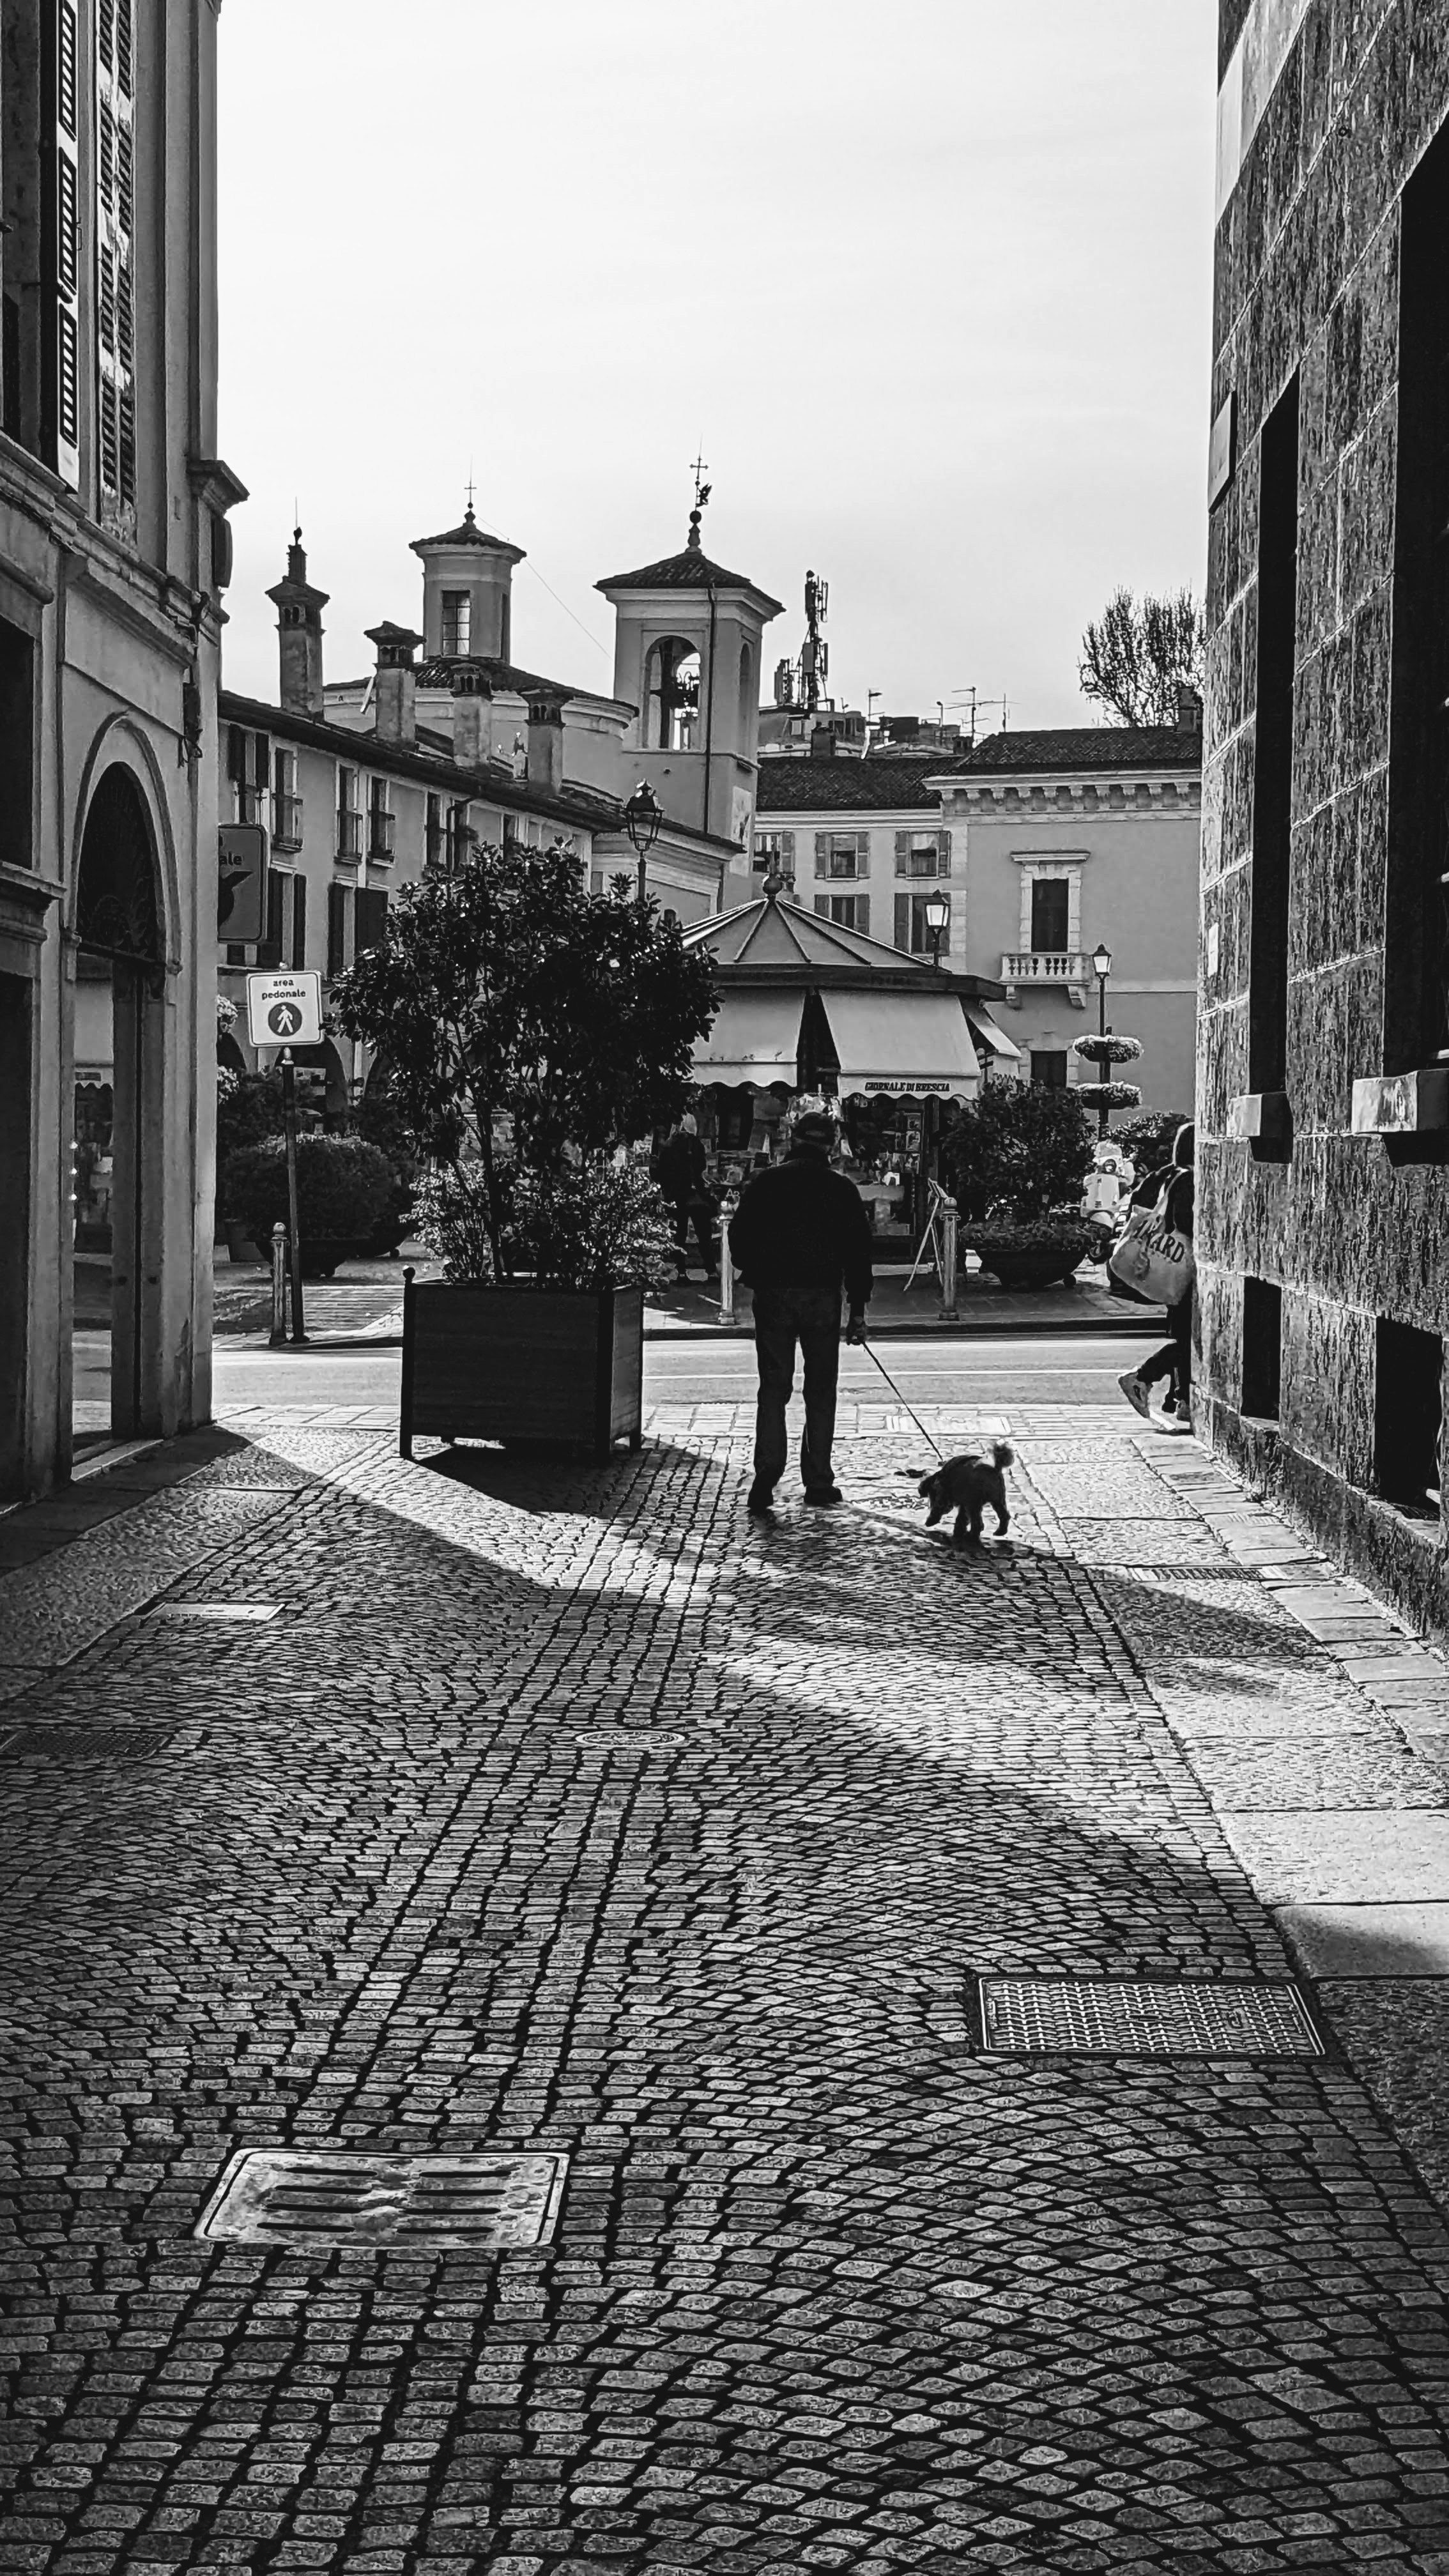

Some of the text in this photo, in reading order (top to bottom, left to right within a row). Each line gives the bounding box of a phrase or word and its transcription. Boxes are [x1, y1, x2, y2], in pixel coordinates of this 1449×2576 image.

[261, 988, 306, 1000] pedonale
[906, 1083, 915, 1091] DI
[915, 1083, 950, 1092] BRESCIA
